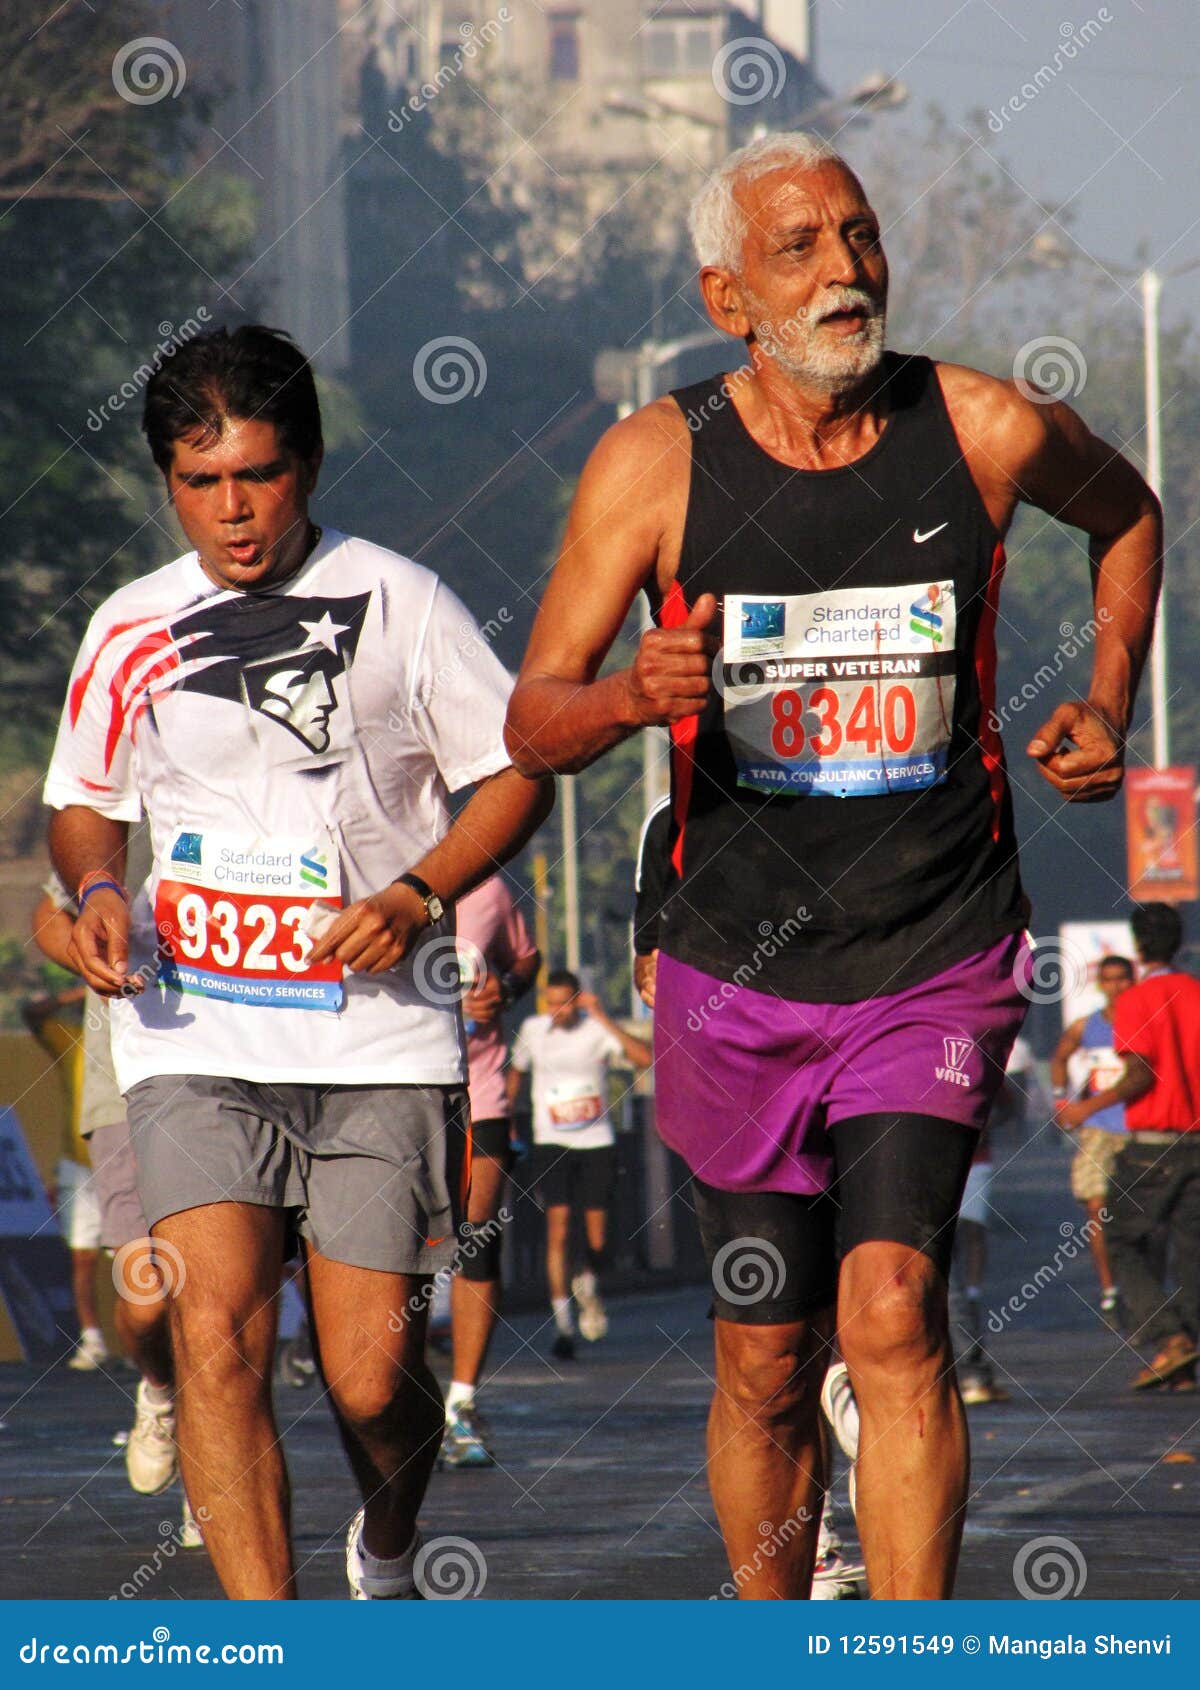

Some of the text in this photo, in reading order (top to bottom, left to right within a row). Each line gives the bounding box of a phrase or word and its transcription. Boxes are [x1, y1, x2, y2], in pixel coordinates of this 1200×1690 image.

[813, 604, 901, 622] Standard
[804, 624, 901, 644] Chartered
[765, 659, 921, 678] SUPER VETERAN
[771, 684, 917, 758] 8340
[751, 768, 787, 782] TATA
[790, 768, 882, 784] CONSULTANCY
[220, 848, 292, 867] Standard
[214, 865, 292, 885] Chartered
[176, 893, 314, 973] 9323
[172, 970, 326, 999] TATA CONSULTANCY SERVICES
[935, 1067, 970, 1087] VATS
